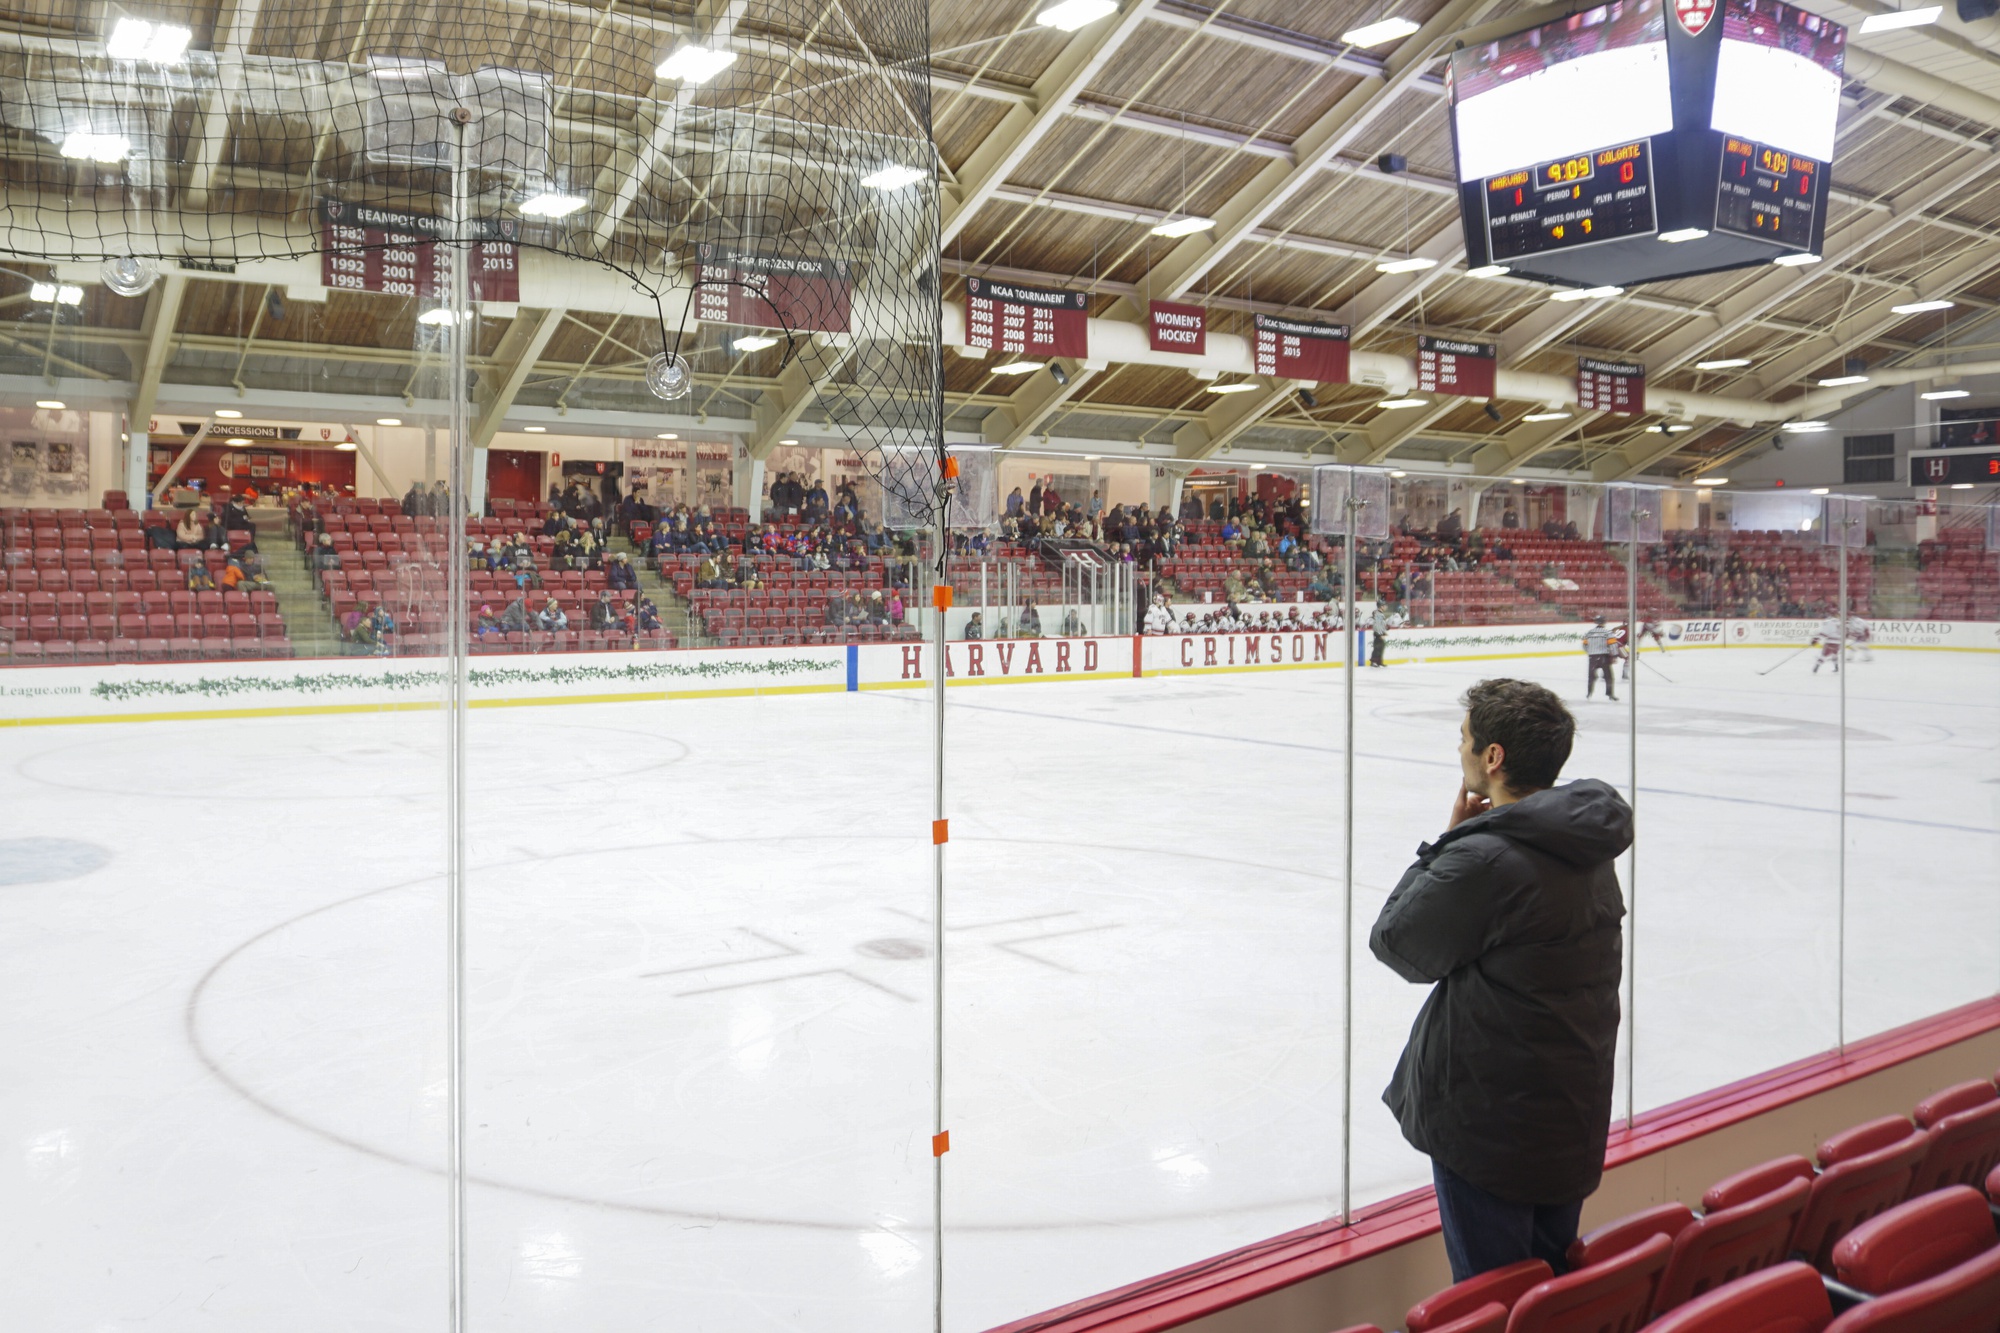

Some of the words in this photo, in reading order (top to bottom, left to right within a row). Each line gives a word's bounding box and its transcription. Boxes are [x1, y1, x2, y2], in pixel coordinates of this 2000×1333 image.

[1598, 144, 1640, 166] COLGATE
[1762, 150, 1788, 173] 9:09
[1548, 157, 1590, 182] 9:09
[1620, 161, 1634, 184] 0
[1740, 160, 1746, 177] 1
[1489, 172, 1528, 192] HARVARD
[1800, 175, 1809, 195] 0
[1514, 188, 1522, 206] 1
[1546, 189, 1570, 202] PERIOD
[1595, 193, 1612, 204] PLYR
[1616, 185, 1646, 199] PENALTY
[1752, 200, 1764, 210] SHOTS
[358, 208, 416, 226] BEANPOT
[418, 218, 488, 233] CHAMONS
[1491, 216, 1506, 226] PLYR
[1510, 208, 1537, 222] PENALTY
[1544, 214, 1564, 226] SHOTS
[1566, 212, 1574, 220] ON
[1576, 208, 1594, 219] GOAL
[331, 224, 364, 240] 1982
[482, 242, 512, 254] 2010
[382, 249, 416, 263] 2000
[728, 252, 754, 266] NCAA
[758, 257, 794, 270] FROZEN
[797, 261, 822, 272] FOUR
[330, 258, 364, 273] 1992
[482, 258, 514, 270] 2015
[382, 264, 415, 280] 2001
[702, 265, 728, 278] 2001
[330, 274, 364, 288] 1995
[382, 280, 415, 296] 2002
[991, 285, 1014, 298] NCAA
[1015, 289, 1066, 304] TOURNAMENT
[700, 294, 728, 306] 2004
[971, 298, 993, 310] 2001
[700, 308, 728, 321] 2005
[971, 310, 994, 322] 2003
[1004, 304, 1026, 316] 2006
[1004, 316, 1026, 328] 2007
[1033, 320, 1054, 332] 2014
[1154, 311, 1202, 328] WOMEN'S
[971, 322, 993, 336] 2004
[1003, 328, 1025, 340] 2008
[1264, 319, 1278, 328] ECAC
[1313, 326, 1342, 336] CHAMPIONS
[970, 335, 992, 348] 2005
[1033, 332, 1054, 344] 2015
[1160, 328, 1198, 343] HOCKEY
[1258, 331, 1276, 342] 1999
[1284, 336, 1300, 346] 2008
[1003, 341, 1024, 354] 2010
[1284, 347, 1300, 357] 2015
[1258, 354, 1276, 364] 2005
[1258, 365, 1276, 376] 2006
[1442, 374, 1457, 384] 2015
[208, 425, 274, 436] CONCESSIONS
[632, 448, 656, 458] MEN'S
[660, 451, 686, 460] PLAYE
[1155, 467, 1165, 478] 16
[1930, 460, 1944, 476] H
[1686, 622, 1722, 632] ECAC
[1684, 633, 1718, 642] HOCKEY
[1870, 636, 1908, 644] LUMNI
[1912, 636, 1941, 645] CARD
[1181, 633, 1329, 667] CRIMSON
